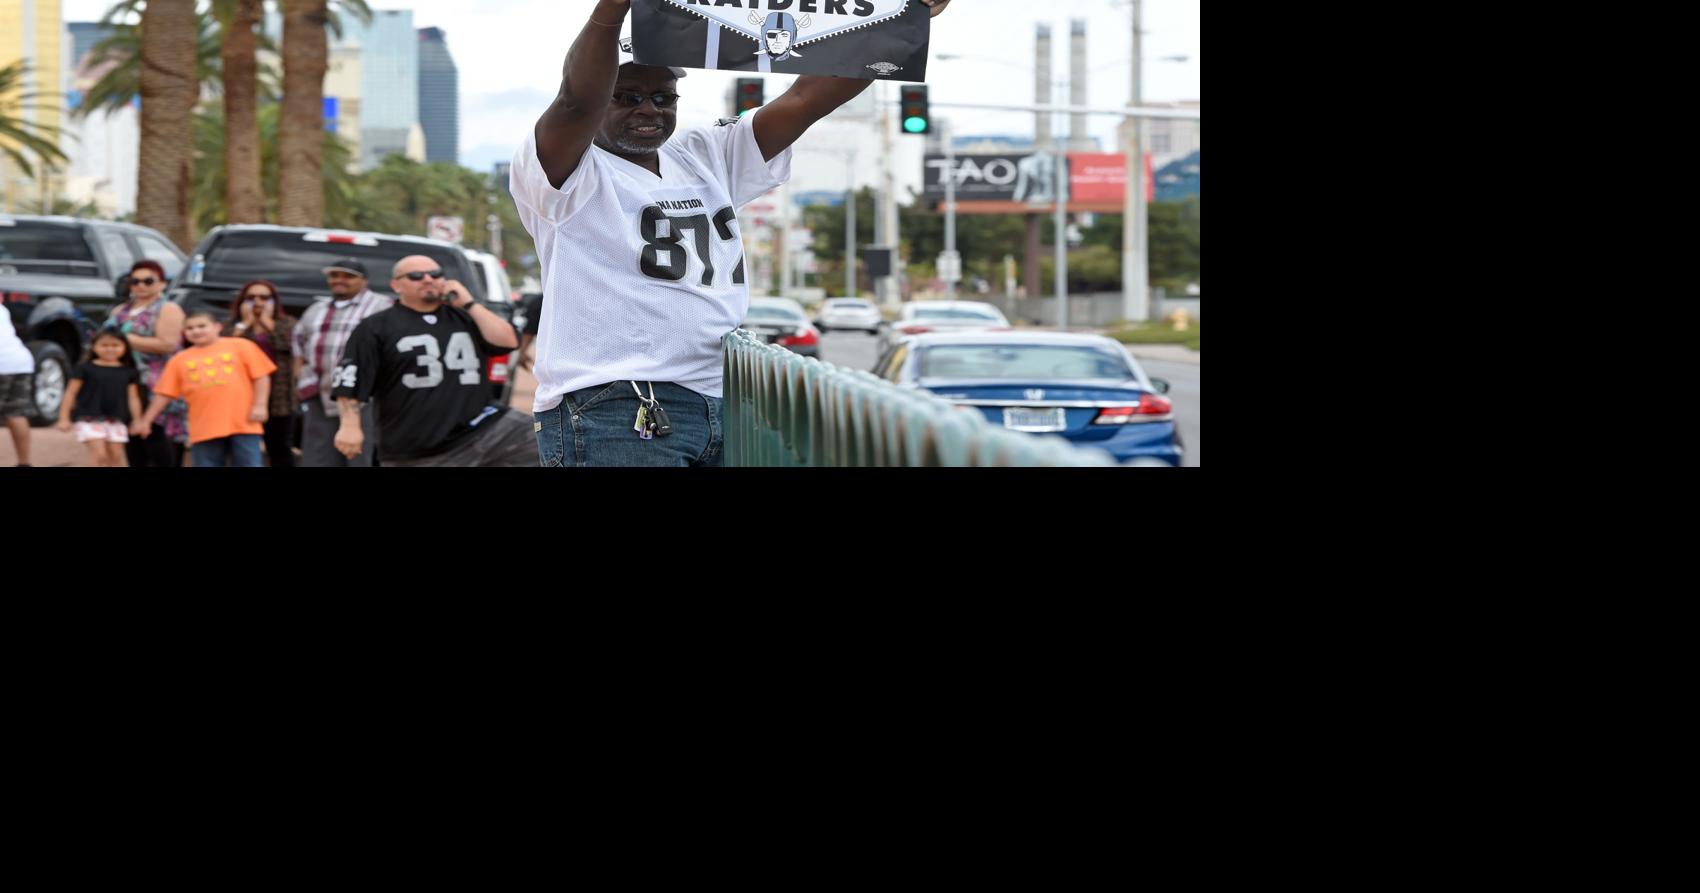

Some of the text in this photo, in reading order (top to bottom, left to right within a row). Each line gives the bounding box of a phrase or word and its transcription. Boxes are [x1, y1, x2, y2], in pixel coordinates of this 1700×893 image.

[925, 157, 1018, 186] TAO
[671, 199, 704, 210] NATION
[396, 332, 480, 388] 34
[332, 364, 358, 388] 34
